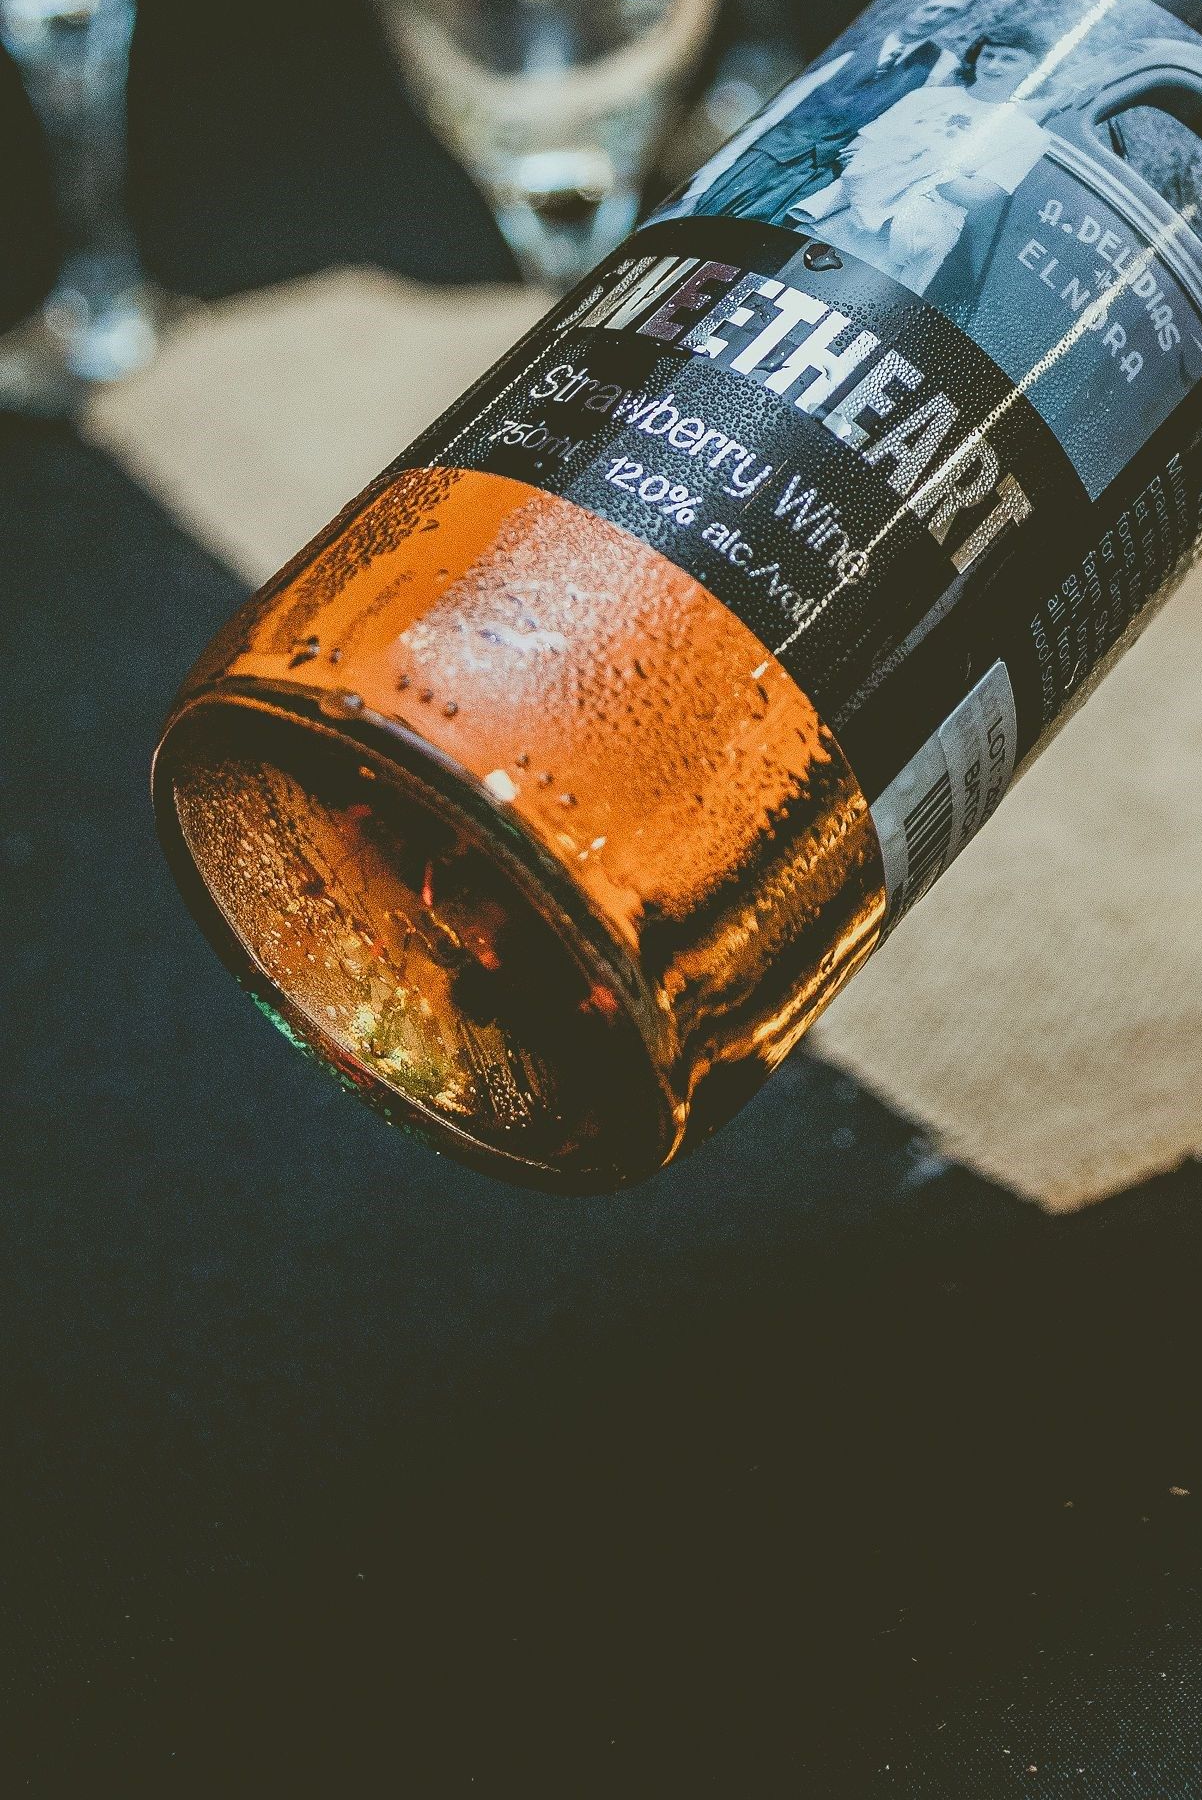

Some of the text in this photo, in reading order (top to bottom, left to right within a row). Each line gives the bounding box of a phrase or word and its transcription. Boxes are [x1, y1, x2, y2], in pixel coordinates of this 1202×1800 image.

[1017, 238, 1144, 383] ELNORA
[530, 364, 869, 584] Strawberry Wine
[604, 454, 703, 527] 12.0%
[1132, 490, 1150, 526] let
[1099, 530, 1115, 563] for
[1047, 594, 1065, 624] all
[1030, 613, 1053, 662] wool
